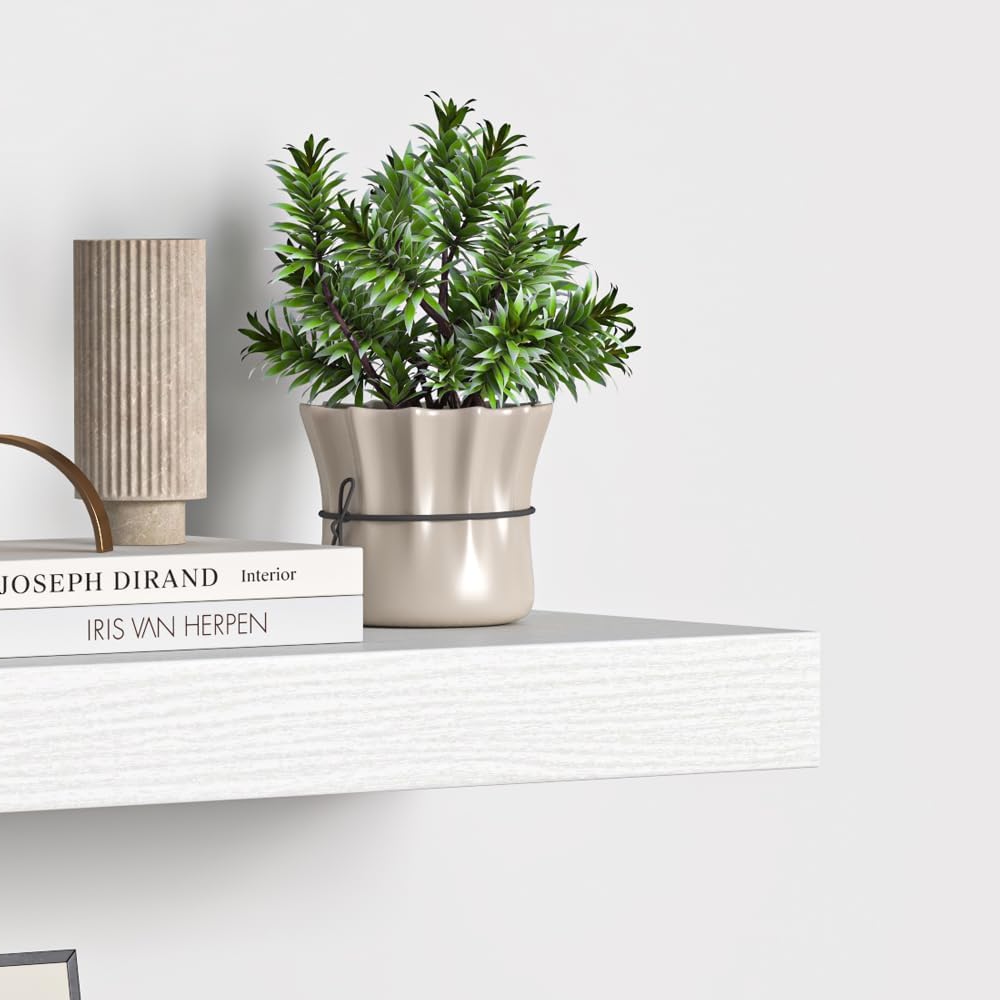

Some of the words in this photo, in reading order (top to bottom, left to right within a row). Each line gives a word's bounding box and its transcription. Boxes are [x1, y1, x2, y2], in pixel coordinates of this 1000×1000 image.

[114, 567, 219, 591] DIRAND
[241, 566, 298, 584] Interior
[87, 617, 125, 641] IRIS
[131, 614, 175, 640] VAN
[184, 611, 268, 637] HERPEN
